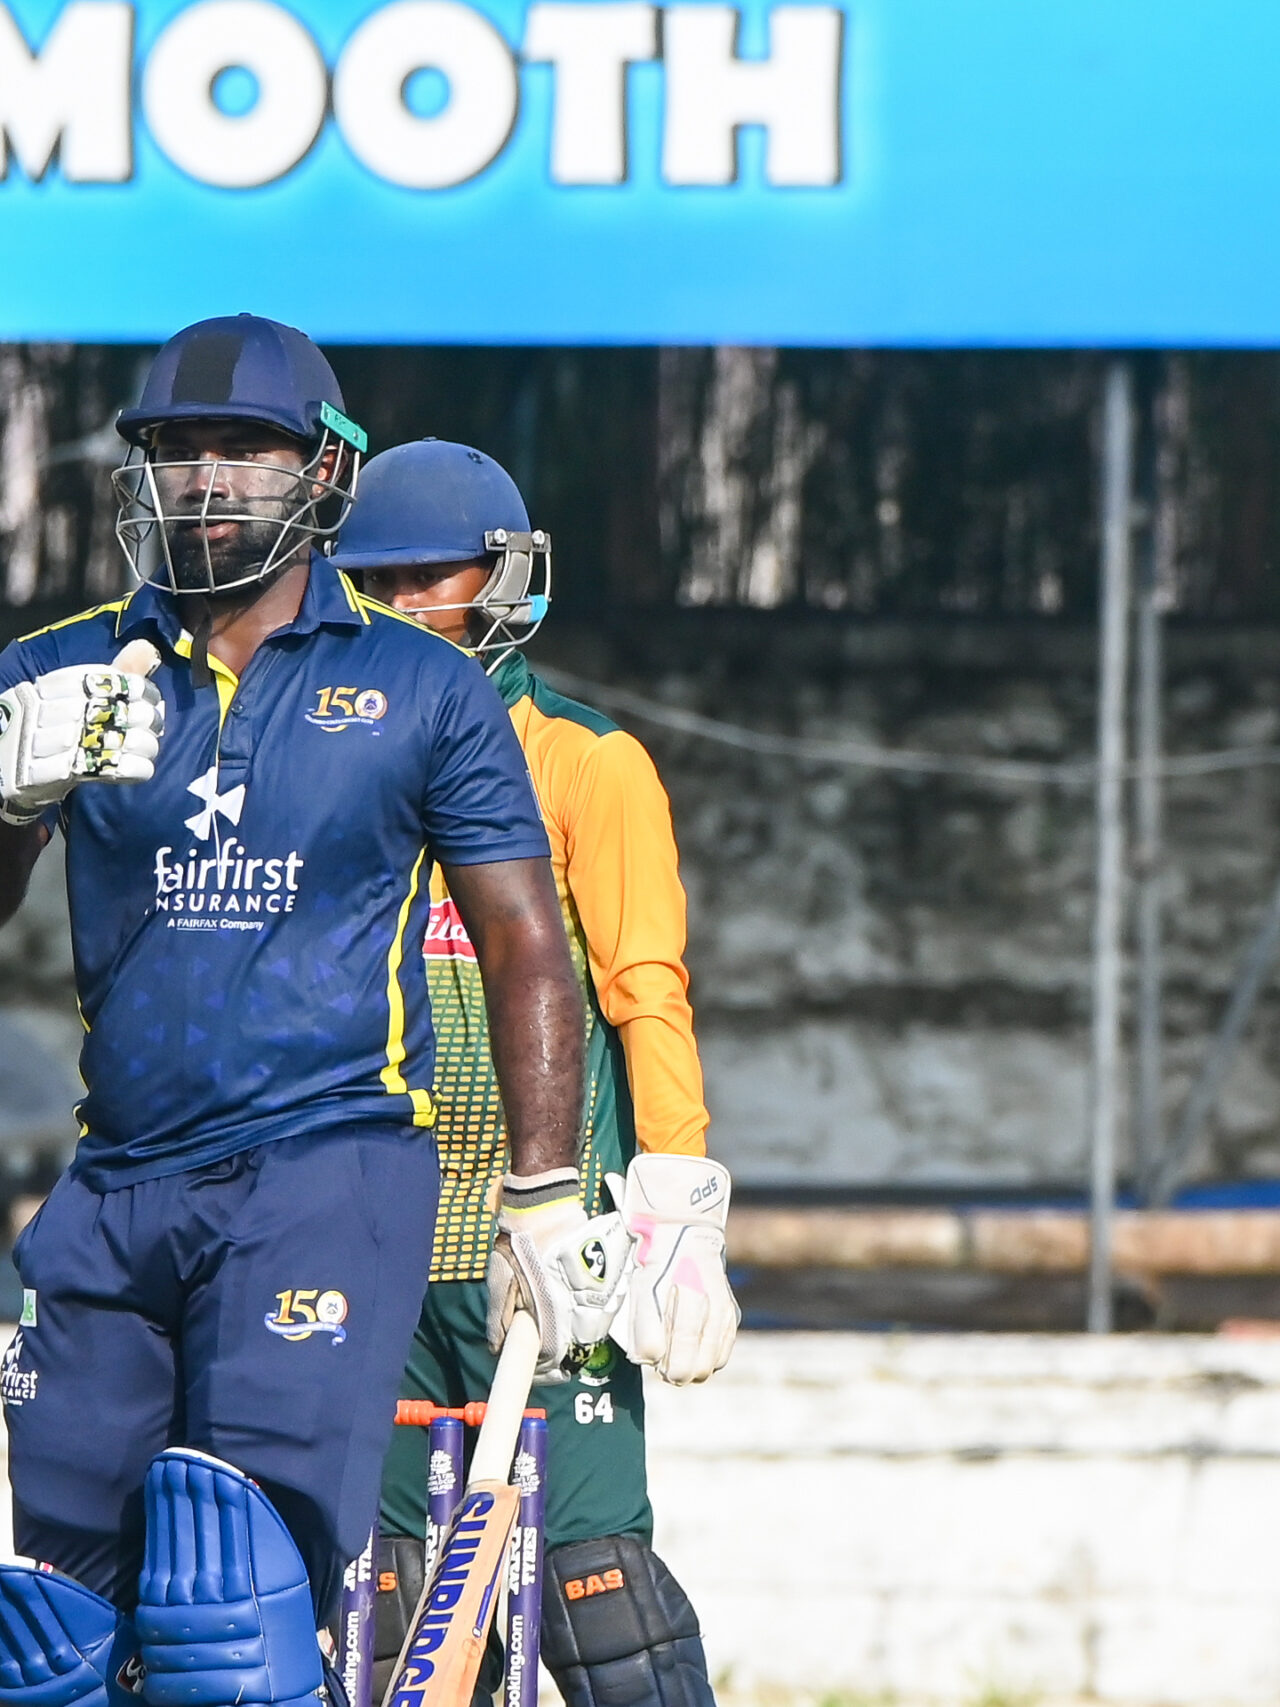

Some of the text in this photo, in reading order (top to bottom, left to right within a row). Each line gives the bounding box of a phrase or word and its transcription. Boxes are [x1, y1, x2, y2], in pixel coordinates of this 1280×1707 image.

[312, 686, 388, 732] 150
[153, 837, 304, 896] fairfirst
[144, 893, 296, 915] NSURANCE
[167, 917, 175, 928] A
[220, 918, 265, 932] Company
[272, 1289, 348, 1341] 150
[574, 1392, 614, 1425] 64
[565, 1568, 624, 1601] BAS
